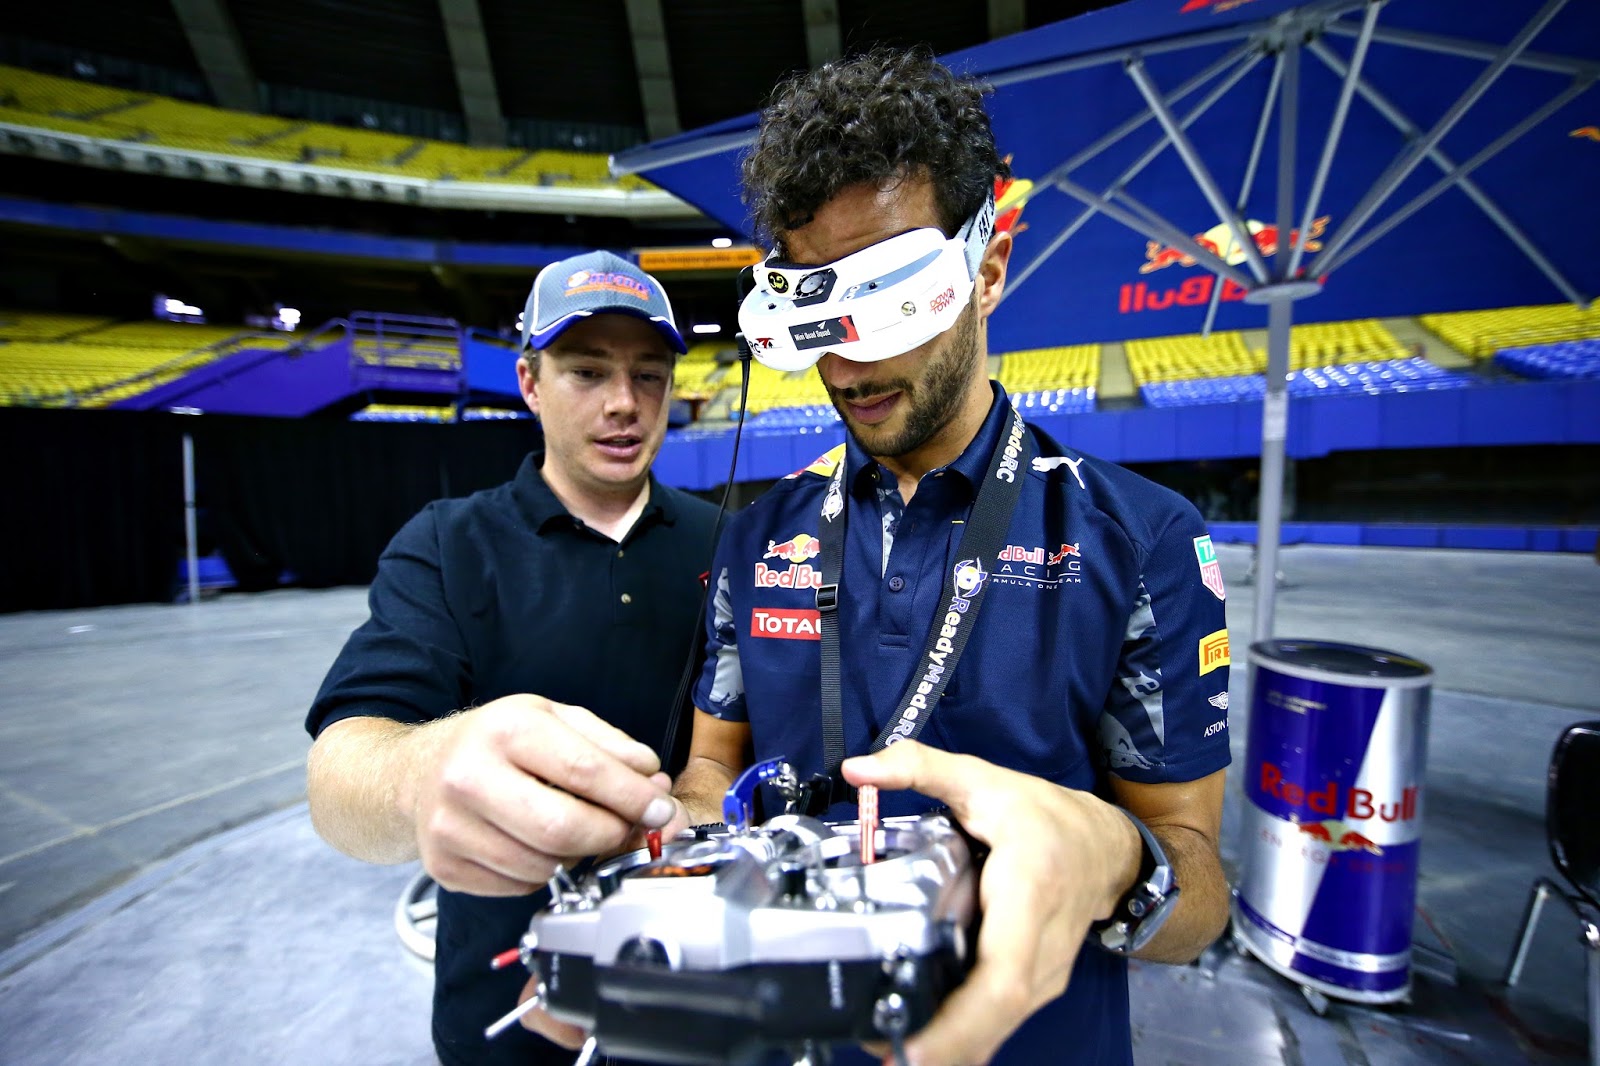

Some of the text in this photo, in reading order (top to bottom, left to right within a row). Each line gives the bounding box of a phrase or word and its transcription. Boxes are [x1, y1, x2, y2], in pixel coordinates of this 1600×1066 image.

[815, 328, 831, 338] Squad
[1198, 541, 1216, 561] TA
[755, 562, 823, 590] Red Bu
[1001, 561, 1080, 578] ACIG
[1203, 565, 1224, 593] HEU
[1204, 637, 1230, 666] PIRE
[884, 597, 970, 747] ReadyMadeRC
[1203, 719, 1226, 738] ASTON
[1260, 761, 1418, 823] Red Bull
